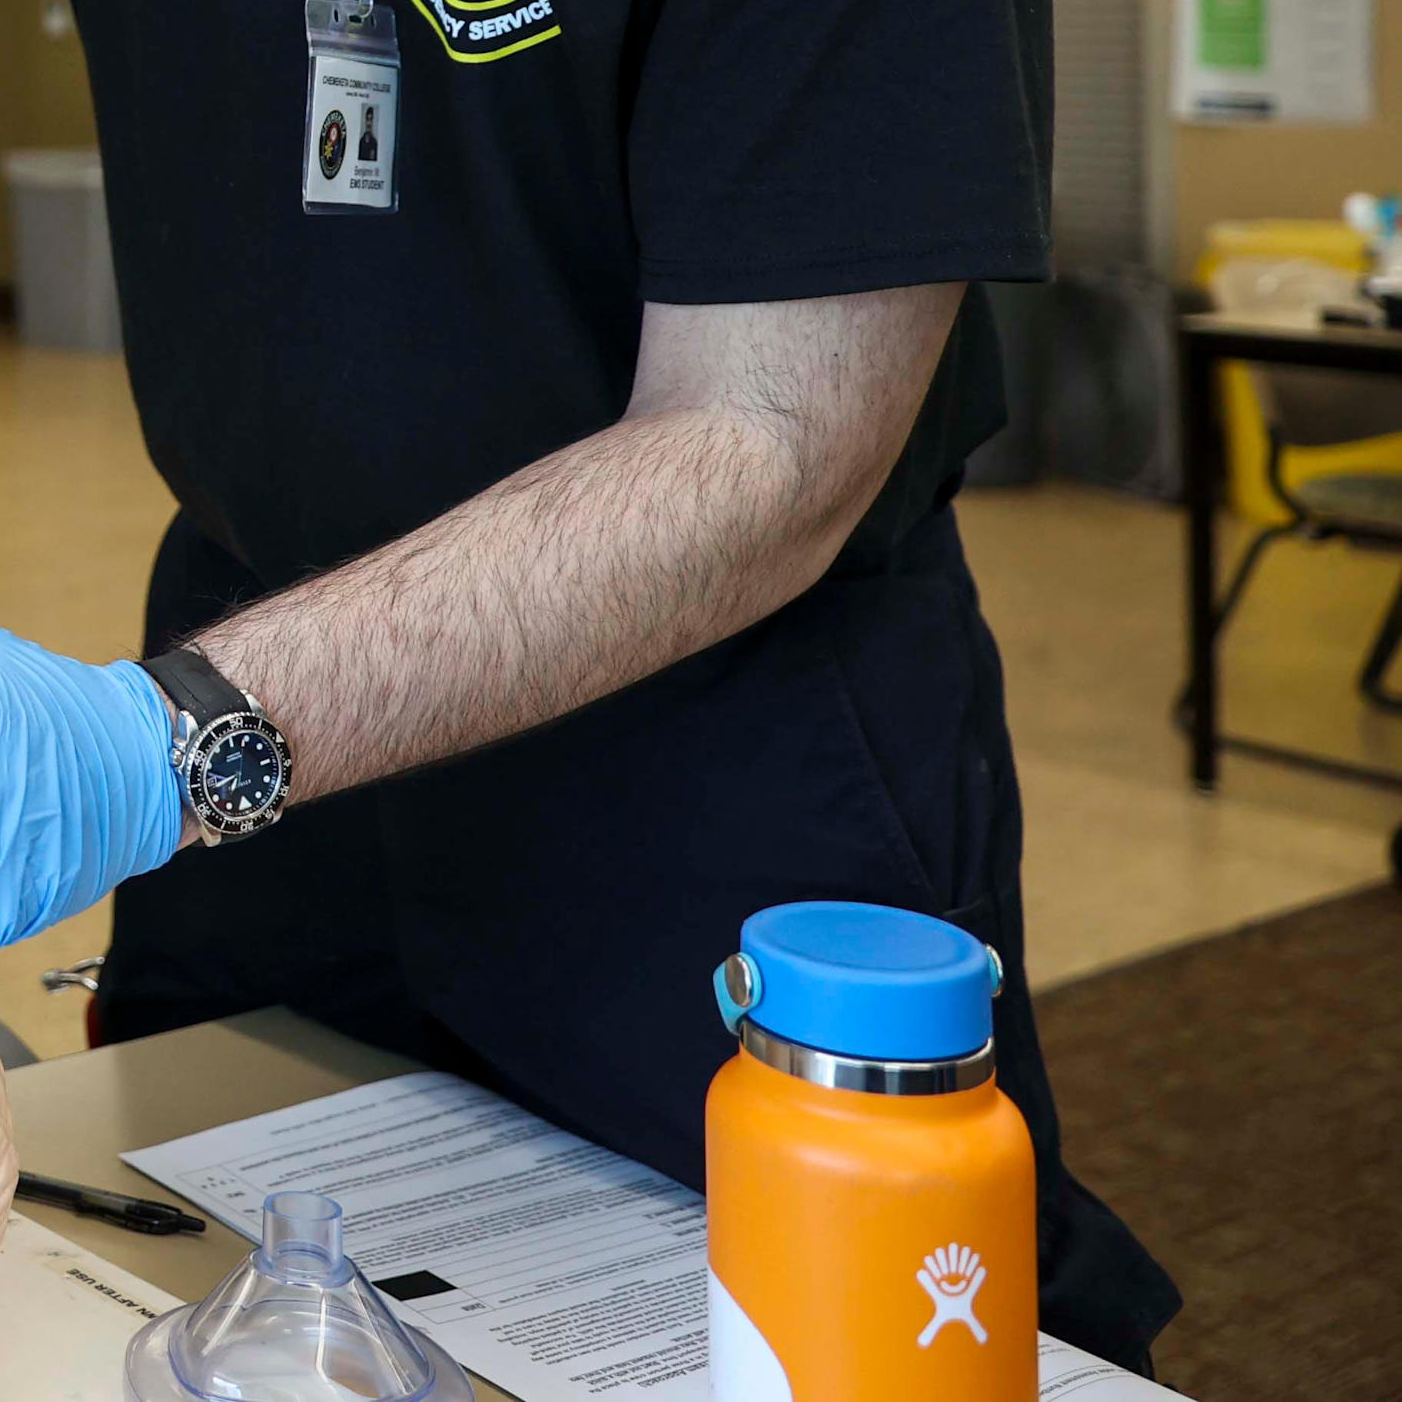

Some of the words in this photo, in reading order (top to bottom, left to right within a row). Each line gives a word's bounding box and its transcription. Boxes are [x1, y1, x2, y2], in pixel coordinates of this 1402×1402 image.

[229, 717, 243, 727] 50
[66, 1268, 96, 1285] USE
[94, 1284, 139, 1308] AFTER
